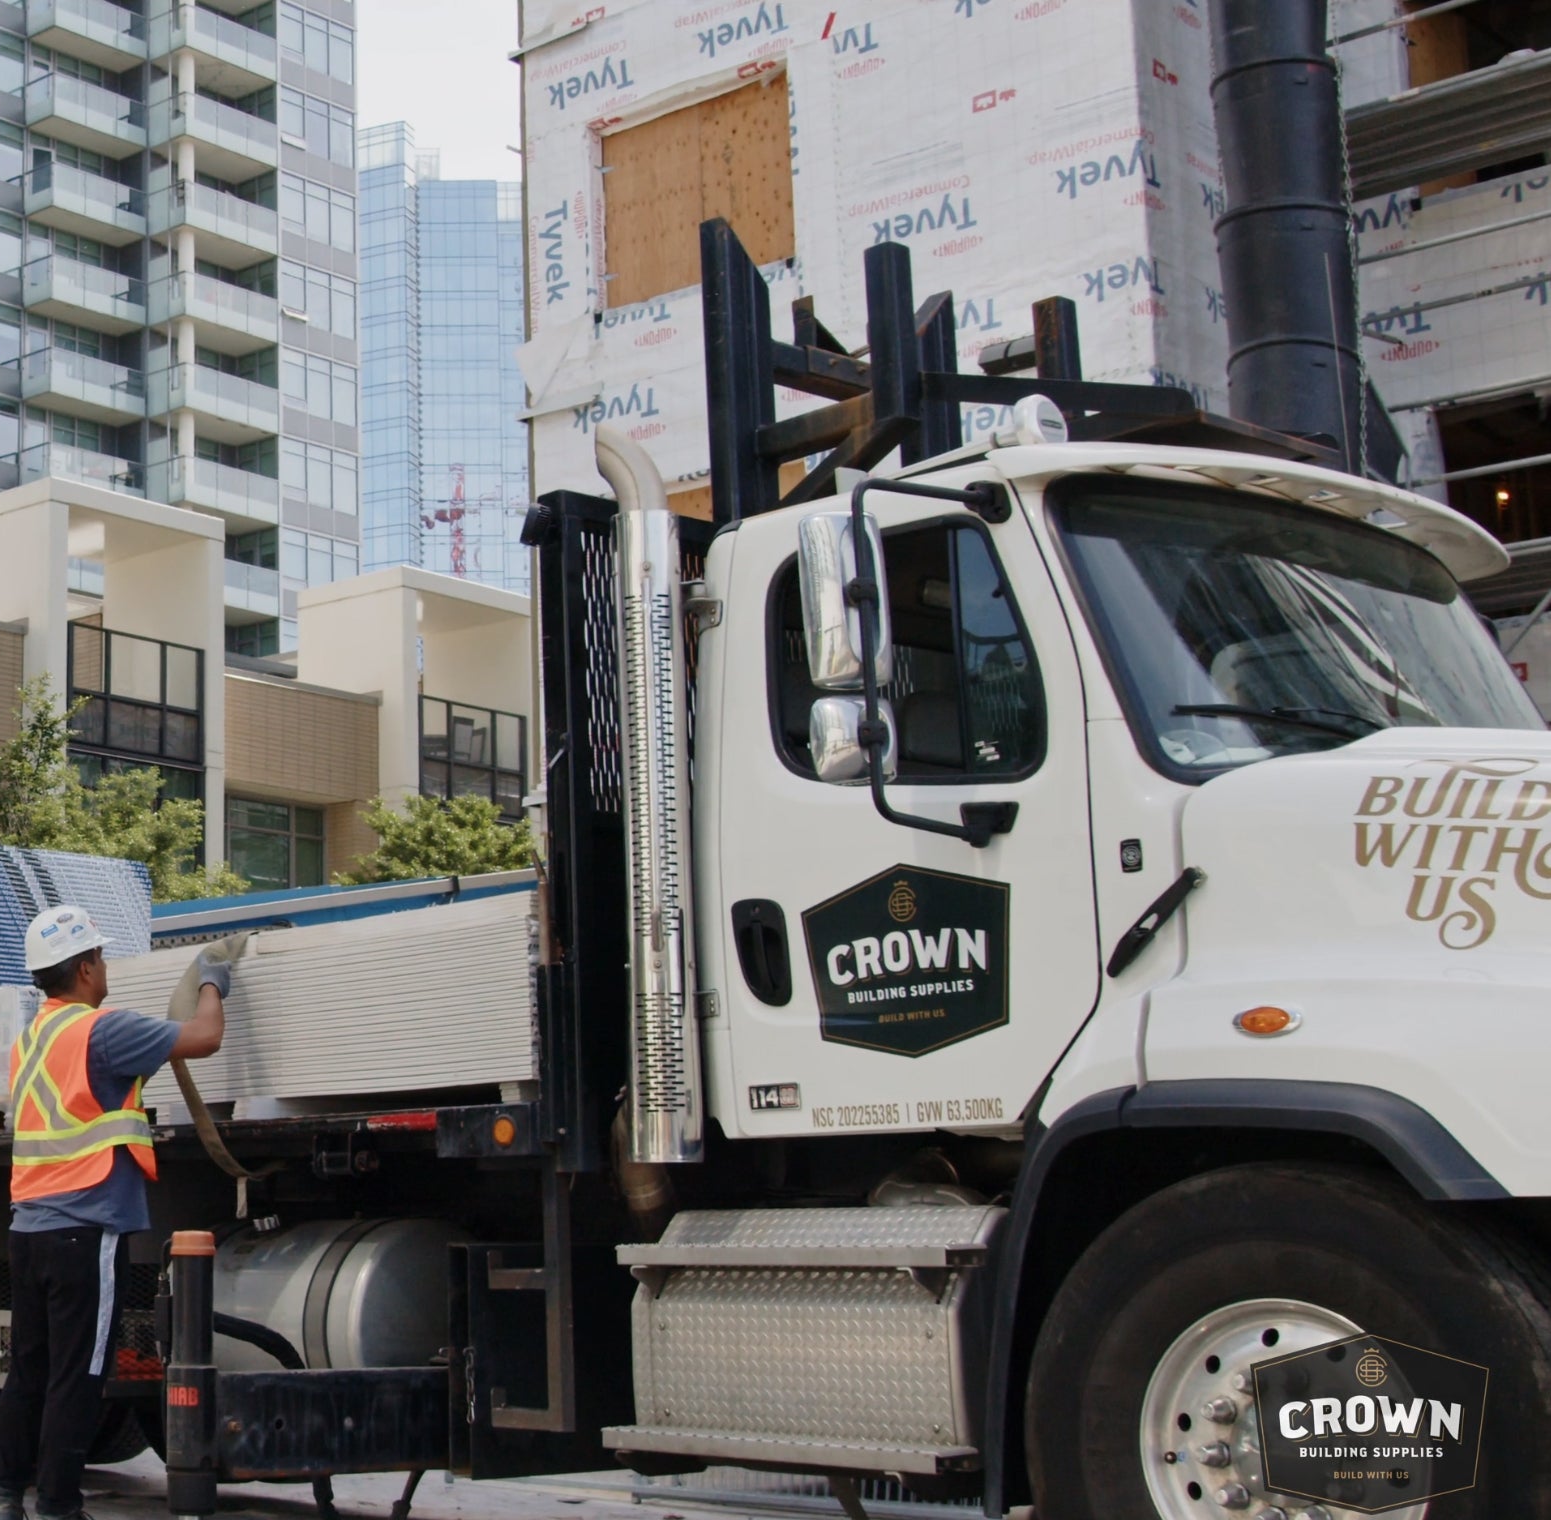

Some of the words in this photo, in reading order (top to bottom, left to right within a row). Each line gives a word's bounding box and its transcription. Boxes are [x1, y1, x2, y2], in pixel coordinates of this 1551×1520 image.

[697, 1, 789, 58] Tyvek
[548, 56, 634, 110] Tyvek
[848, 175, 971, 217] CommercialWrap
[872, 193, 977, 244] Tyvek
[538, 200, 570, 304] Tyvek
[573, 383, 660, 434] Tyvek
[1354, 757, 1551, 821] BUILD
[1354, 822, 1551, 901] WITH
[1405, 874, 1496, 951] US
[826, 927, 988, 987] CROWN
[848, 986, 907, 1004] BUILDING
[910, 979, 975, 997] SUPPLIES
[878, 1012, 904, 1024] BUILD
[907, 1010, 931, 1021] WITH
[933, 1008, 946, 1018] US
[750, 1087, 779, 1109] 114
[812, 1106, 834, 1128] NSC
[837, 1103, 899, 1127] 202255385
[916, 1100, 943, 1123] GVW
[947, 1097, 1003, 1124] 63,500KG
